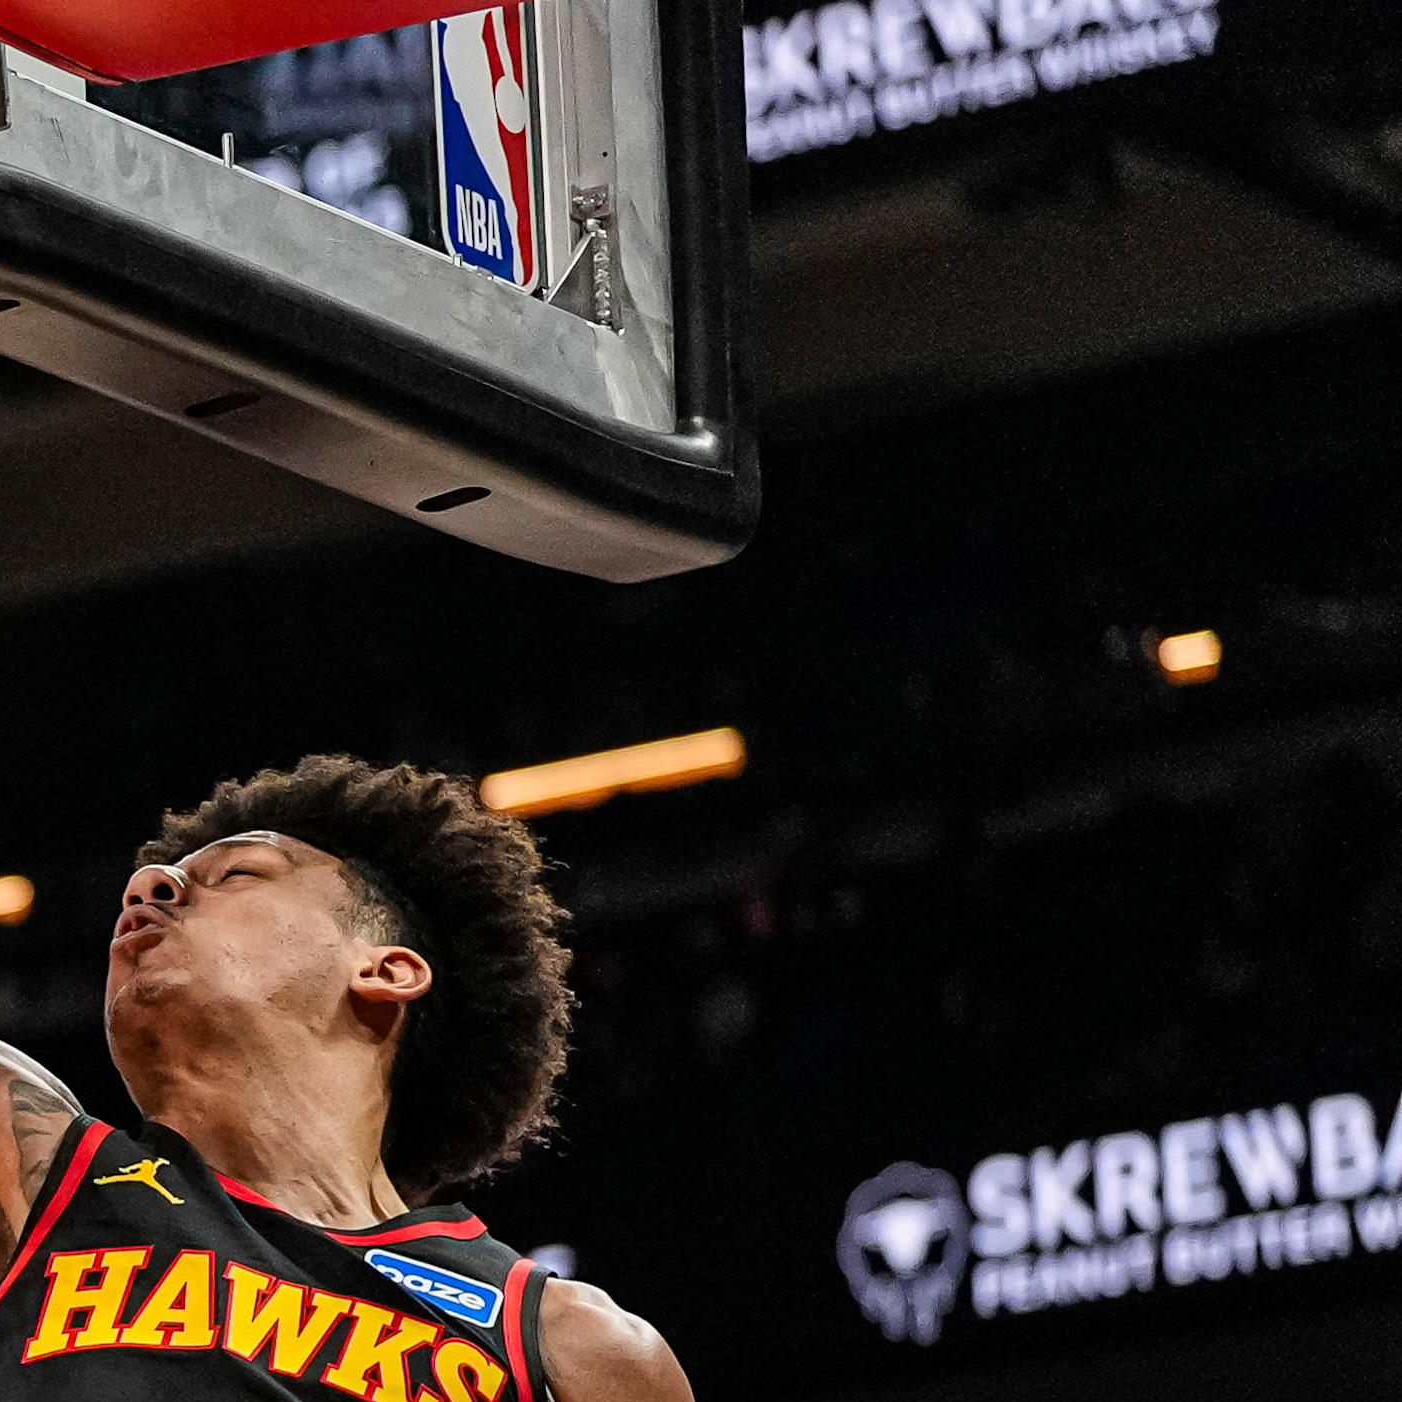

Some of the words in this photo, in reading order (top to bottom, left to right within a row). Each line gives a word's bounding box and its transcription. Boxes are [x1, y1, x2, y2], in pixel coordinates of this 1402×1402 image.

[455, 184, 503, 260] NBA
[967, 1092, 1402, 1258] SKREWB
[971, 1232, 1158, 1320] PEANUT
[1162, 1201, 1352, 1287] BUTTER
